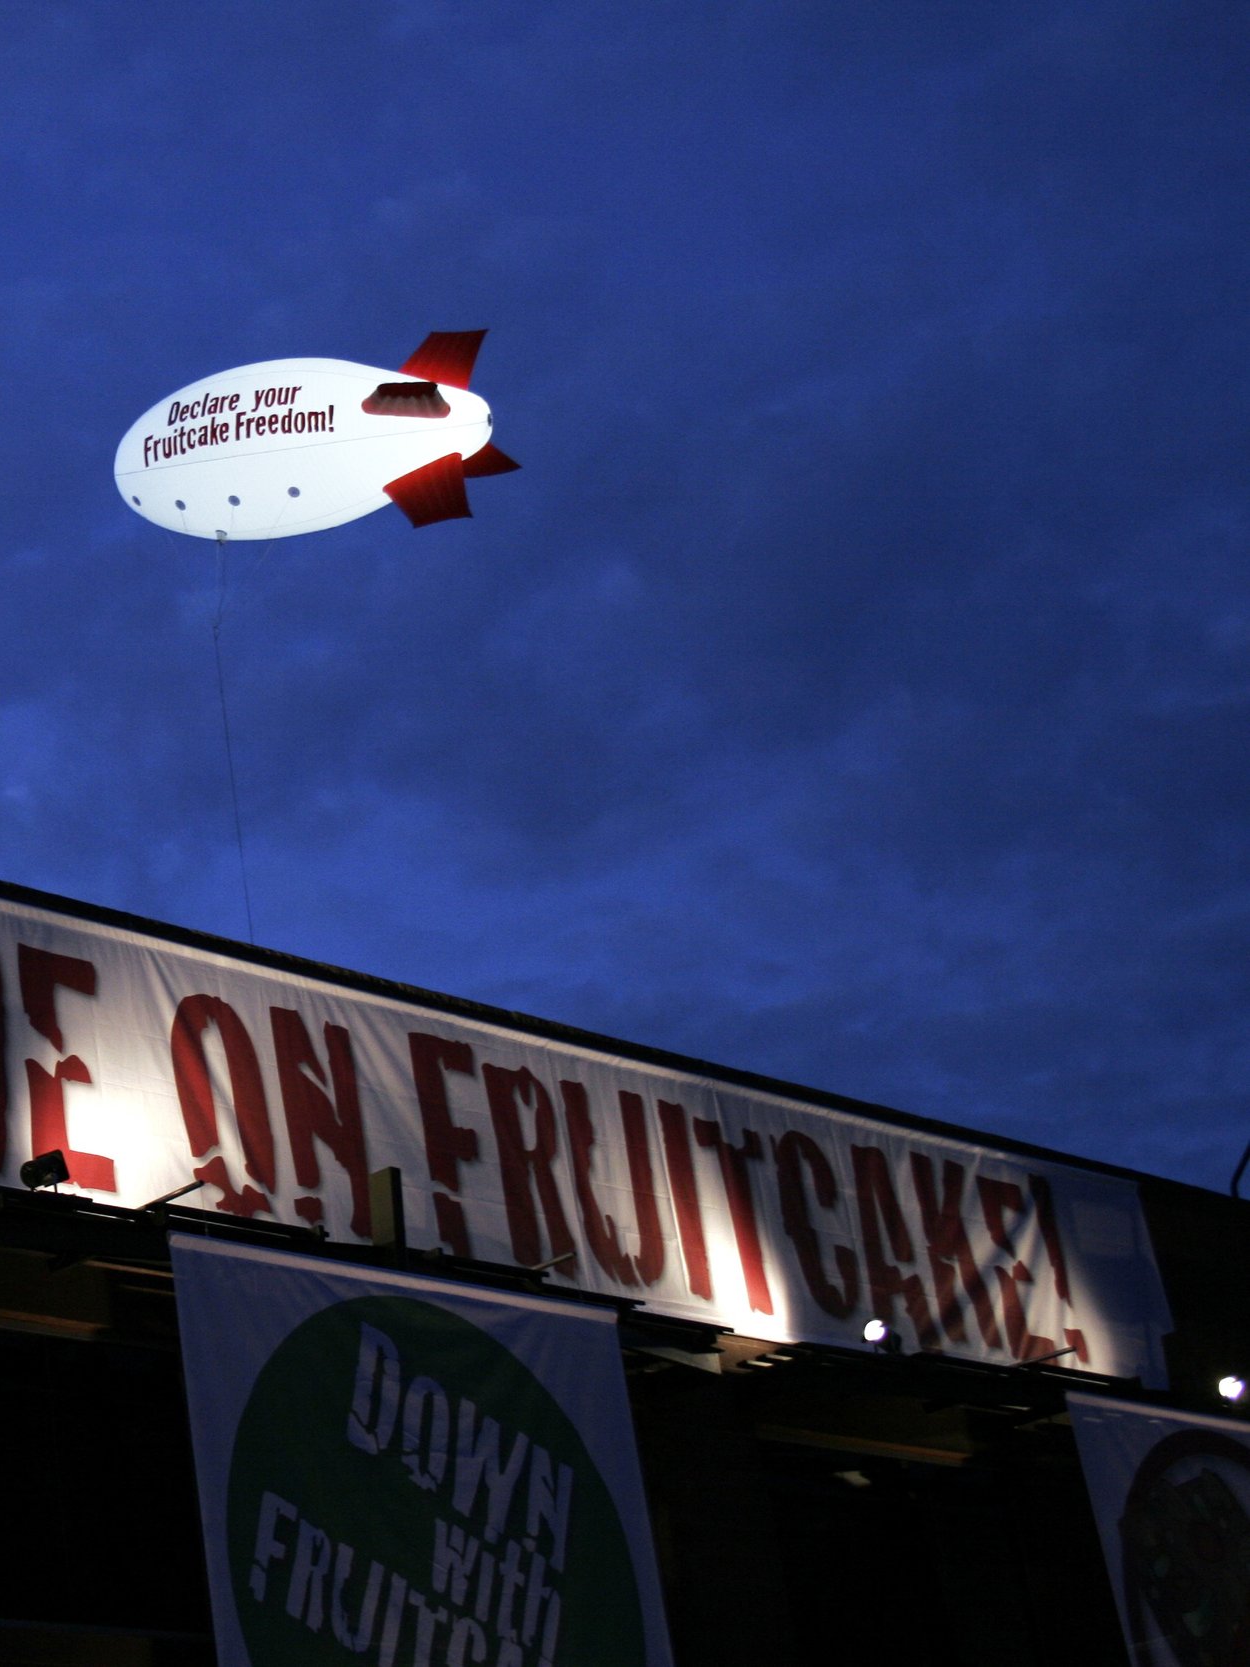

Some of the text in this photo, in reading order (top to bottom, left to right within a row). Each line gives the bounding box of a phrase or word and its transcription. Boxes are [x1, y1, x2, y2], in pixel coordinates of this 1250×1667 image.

[143, 405, 335, 468] Fruitcake Freedom!
[168, 385, 303, 426] Declare your
[171, 994, 373, 1238] ON
[408, 1032, 1089, 1365] FRUITCAKE!
[347, 1320, 575, 1574] DOWN
